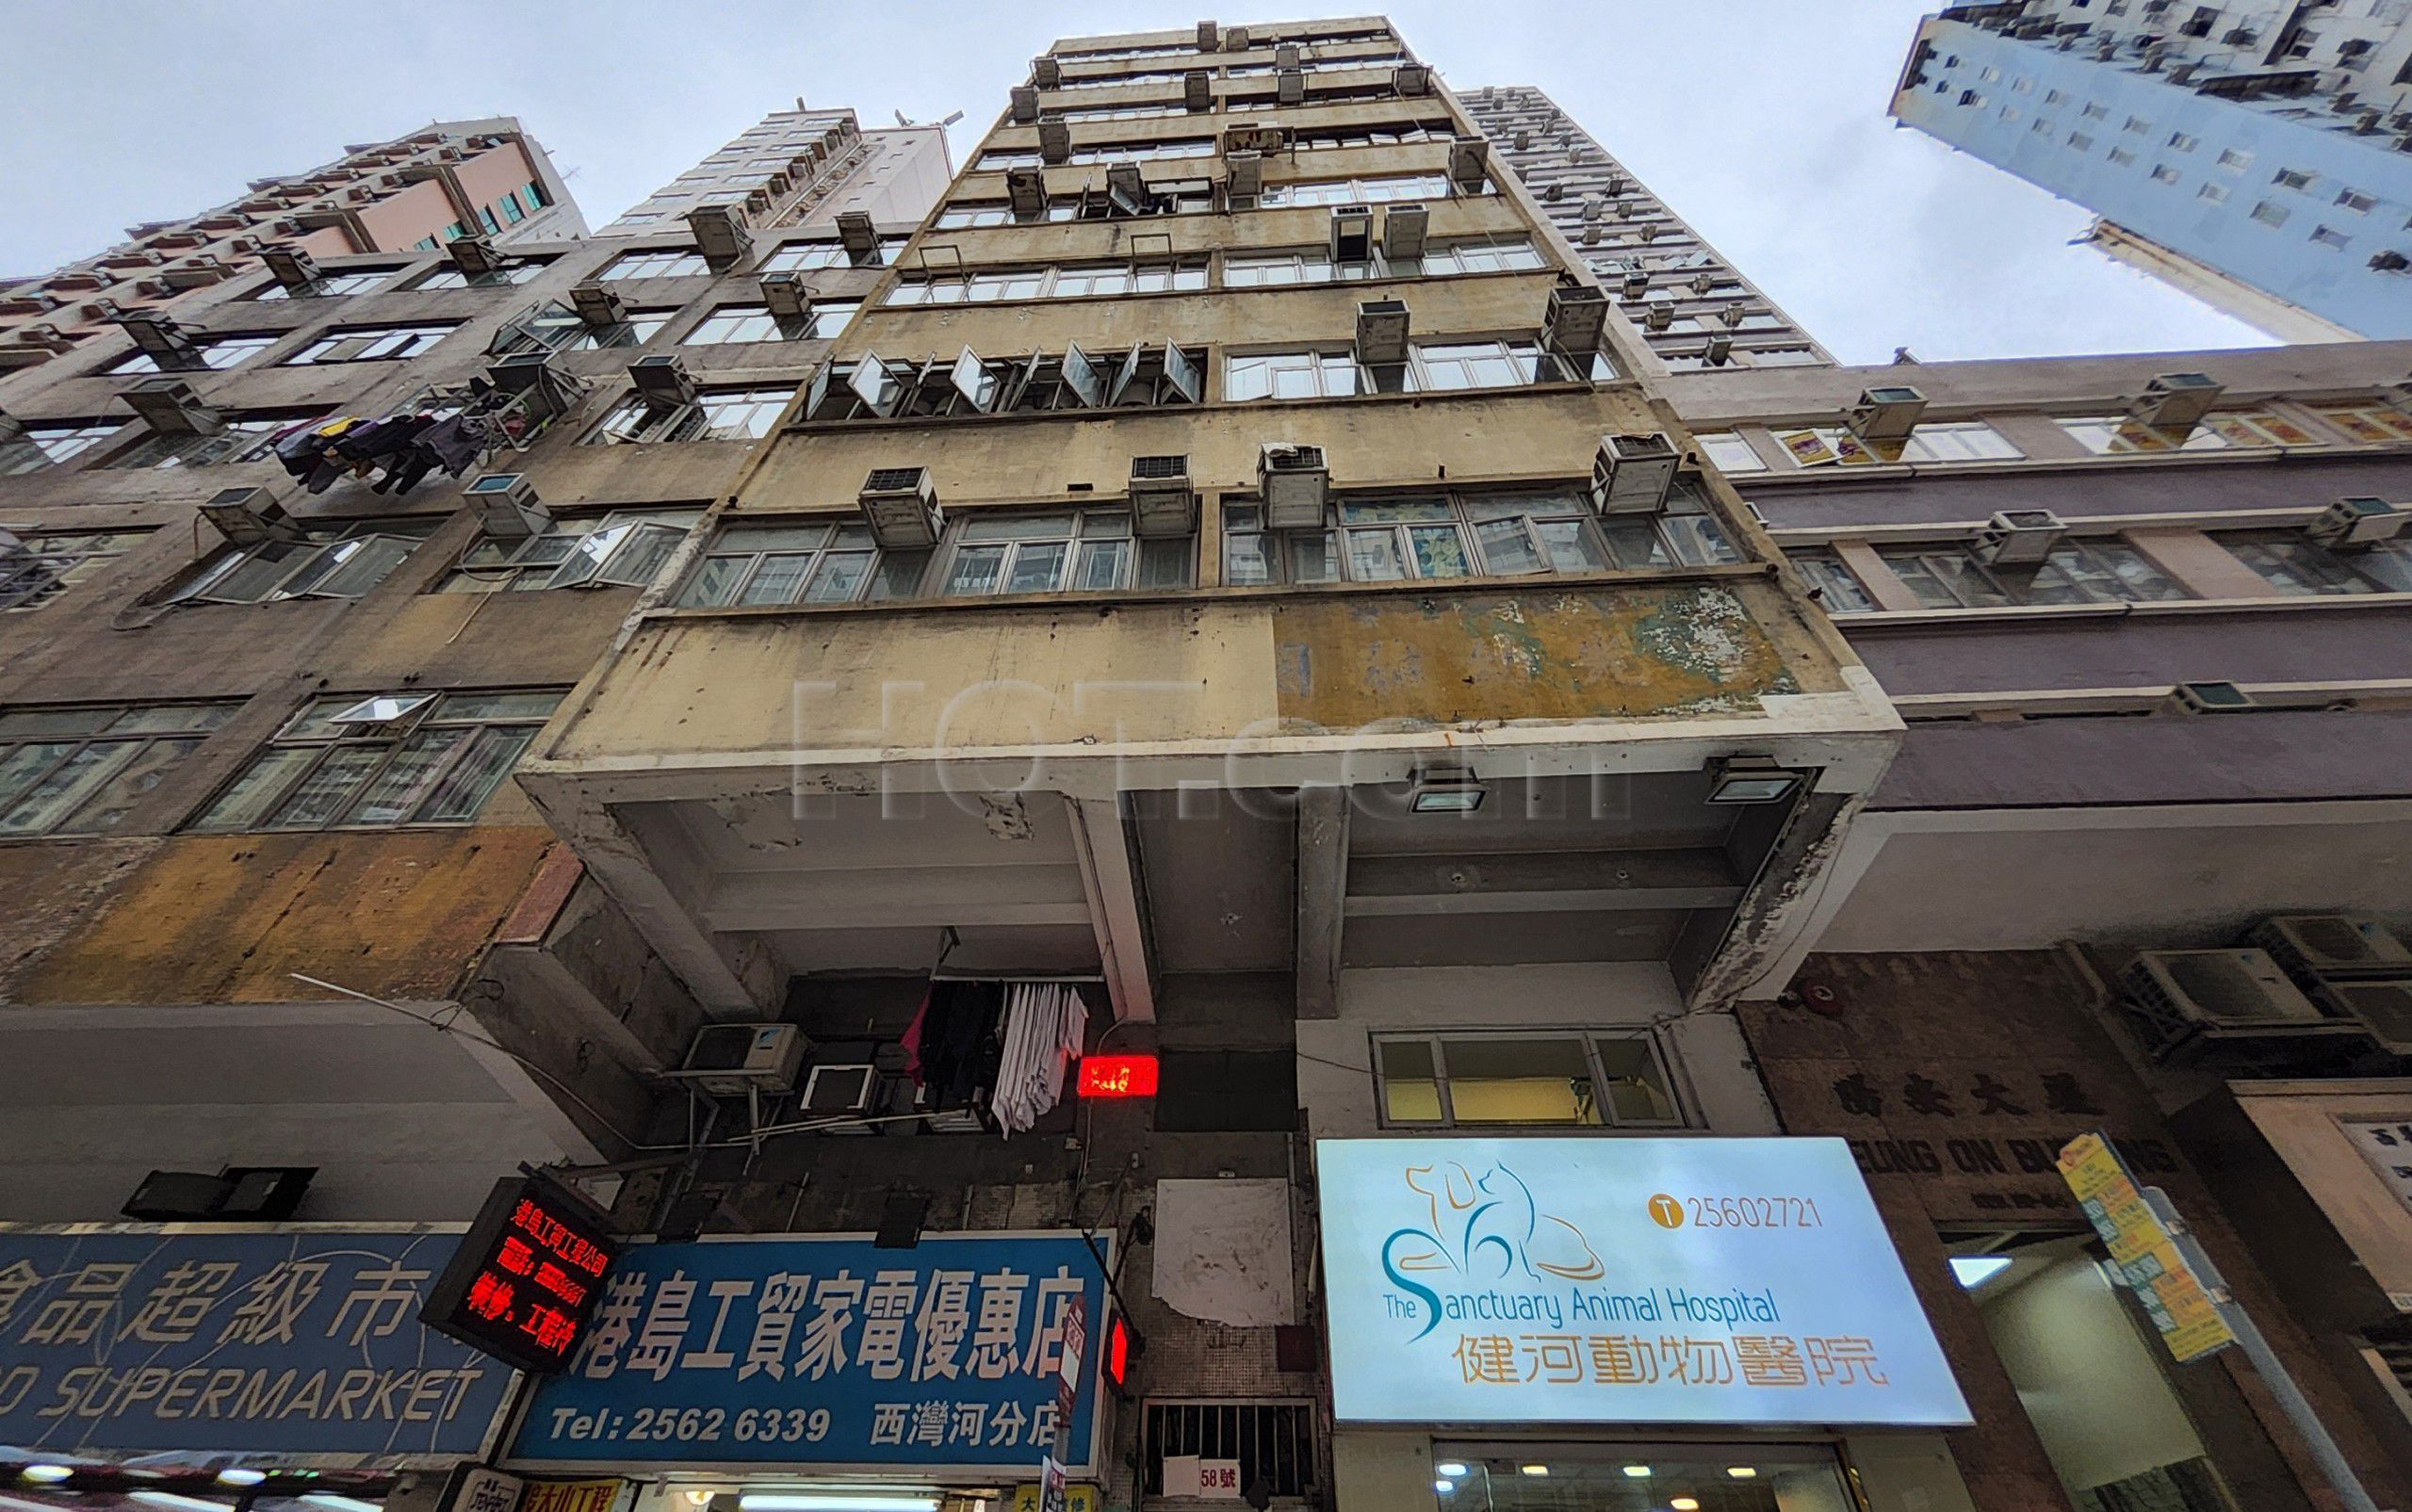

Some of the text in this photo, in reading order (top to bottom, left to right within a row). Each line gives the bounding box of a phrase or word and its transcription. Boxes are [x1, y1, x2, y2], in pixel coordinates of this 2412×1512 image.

[1849, 1140, 1943, 1174] EUNG
[1947, 1139, 2009, 1174] ON
[1687, 1196, 1823, 1227] 25602721
[0, 1259, 460, 1347] 品超級市
[570, 1266, 1084, 1384] 港島工貿家電優惠店
[1382, 1293, 1417, 1320] The
[1573, 1286, 1660, 1323] Animal
[1670, 1288, 1781, 1331] Hospital
[1452, 1332, 1888, 1388] 健河動物醫院
[36, 1367, 484, 1421] SUPERMARKET
[548, 1406, 831, 1442] Tel: 2562 6339
[869, 1400, 1062, 1448] 西灣河分店
[1200, 1469, 1217, 1488] 58
